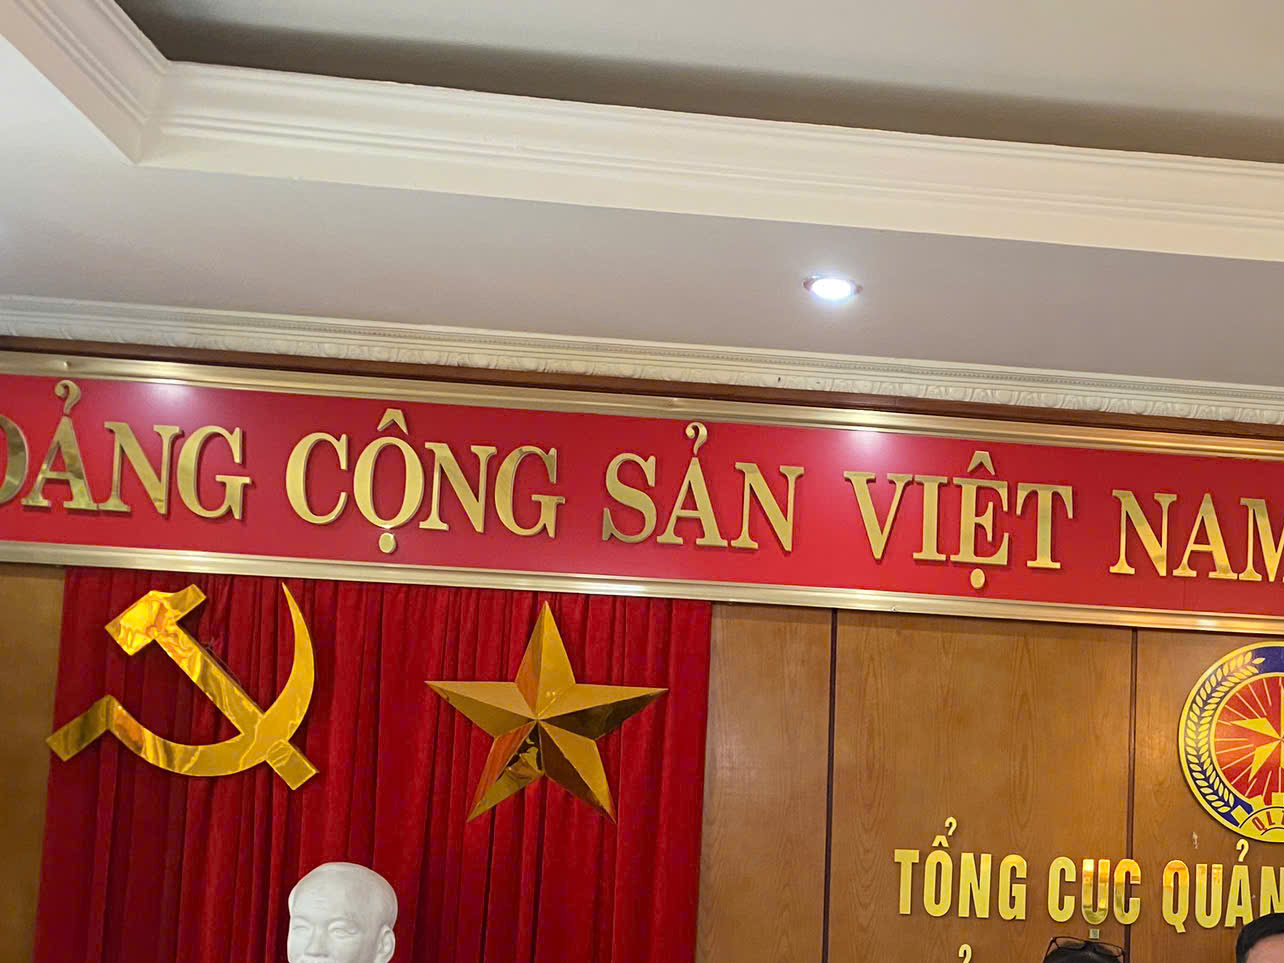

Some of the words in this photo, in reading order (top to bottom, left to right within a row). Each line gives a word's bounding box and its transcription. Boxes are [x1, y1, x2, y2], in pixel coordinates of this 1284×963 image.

[286, 408, 565, 554] CỘNG
[603, 422, 804, 552] SẢN
[844, 451, 1074, 588] VIỆT
[894, 816, 1027, 921] TỔNG
[1048, 857, 1141, 940] CỤC
